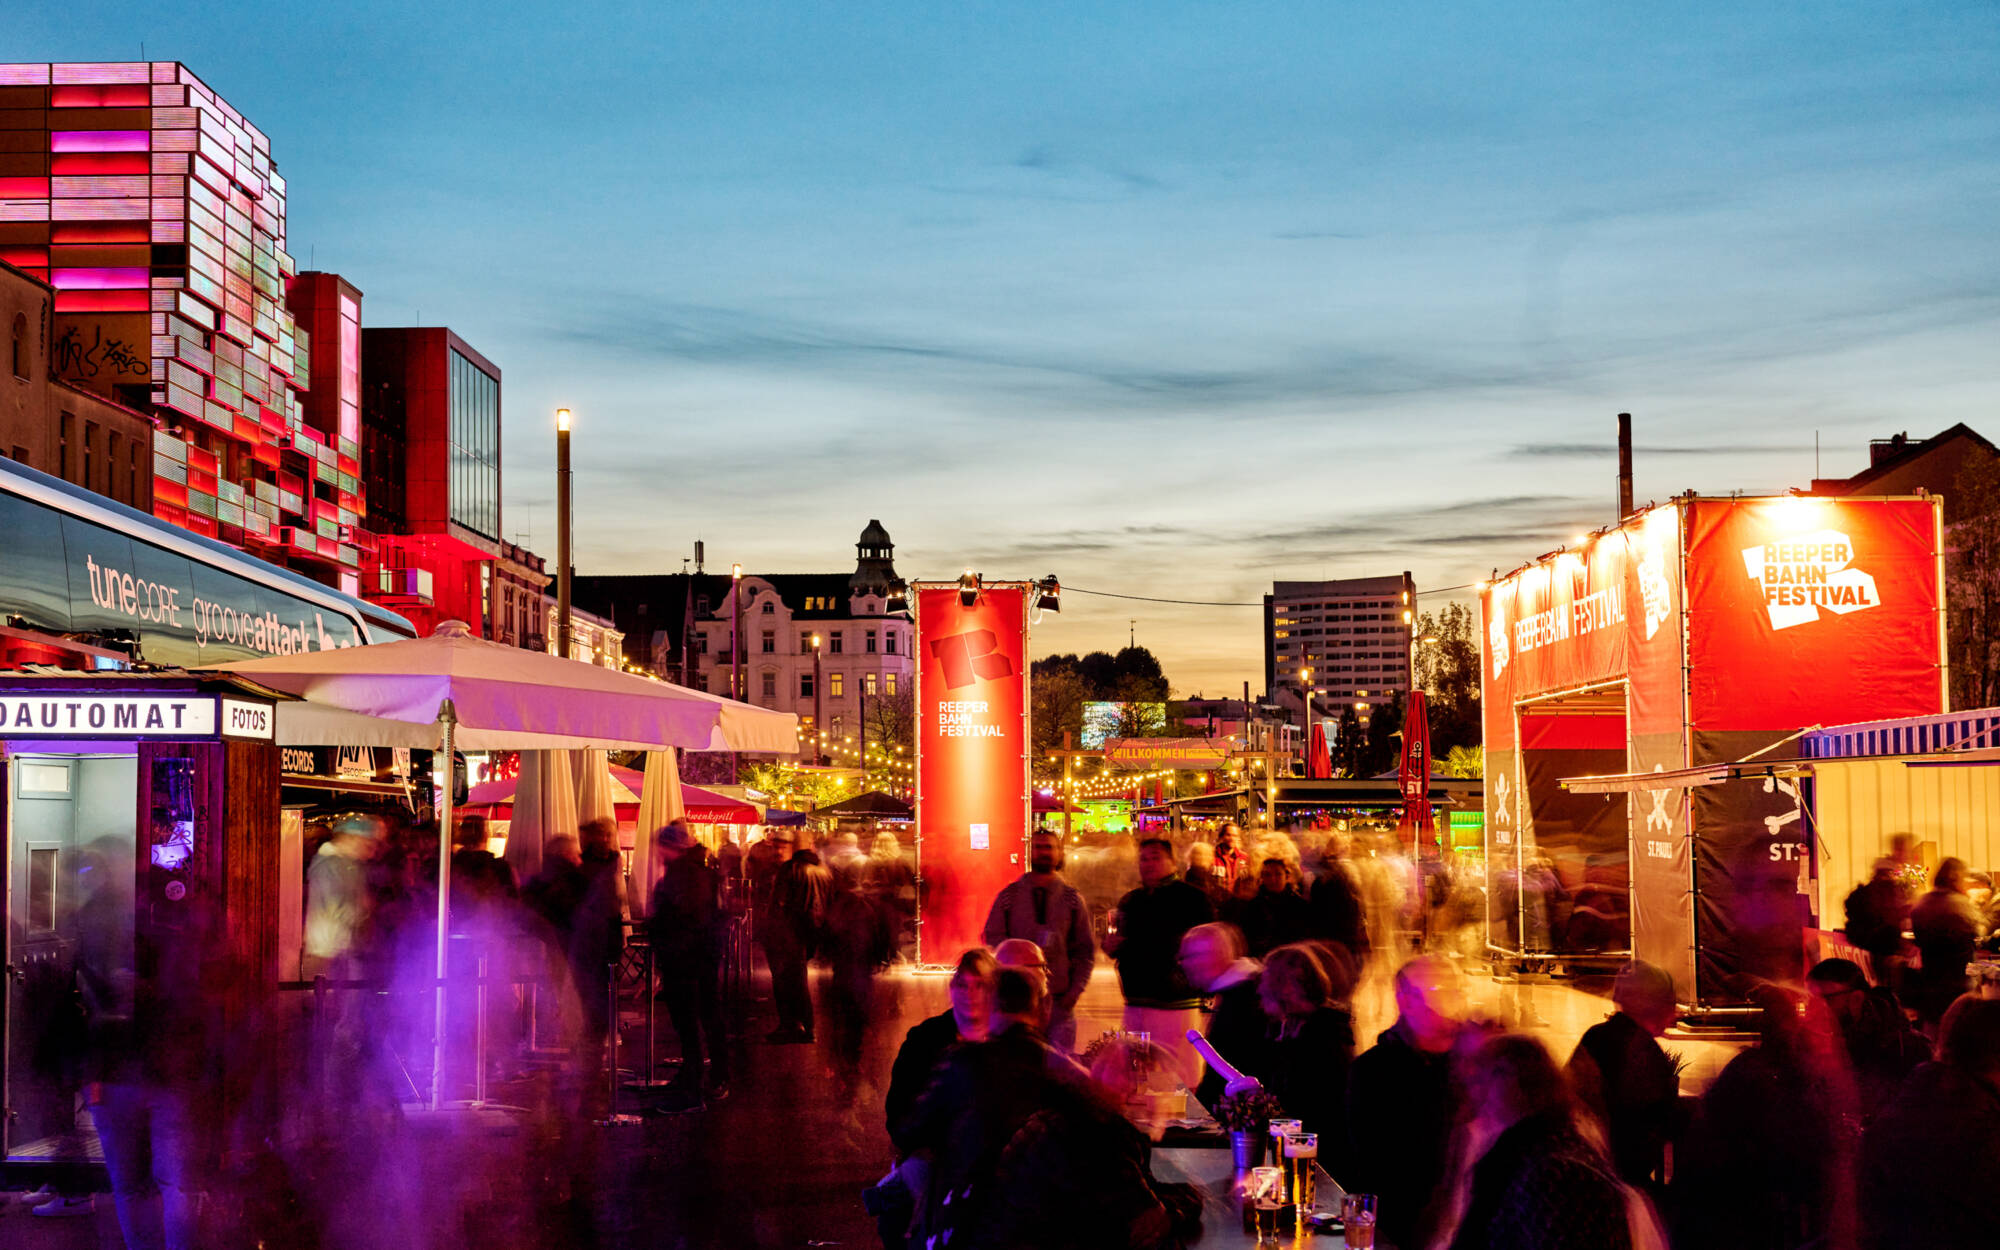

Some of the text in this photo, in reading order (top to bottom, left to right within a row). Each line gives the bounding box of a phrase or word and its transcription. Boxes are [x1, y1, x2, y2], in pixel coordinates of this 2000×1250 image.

[1763, 544, 1848, 562] REEPER
[1764, 565, 1827, 584] BAHN
[1765, 585, 1871, 606] FESTIVAL
[1515, 603, 1569, 654] REEPERBAHN
[1573, 584, 1625, 637] FESTIVAL
[939, 701, 988, 713] REEPER
[232, 707, 266, 731] FOTOS
[939, 713, 972, 725] BAHN
[939, 725, 1005, 737] FESTIVAL
[281, 748, 314, 773] ECORDS
[1112, 748, 1186, 759] WILLKOMMEN
